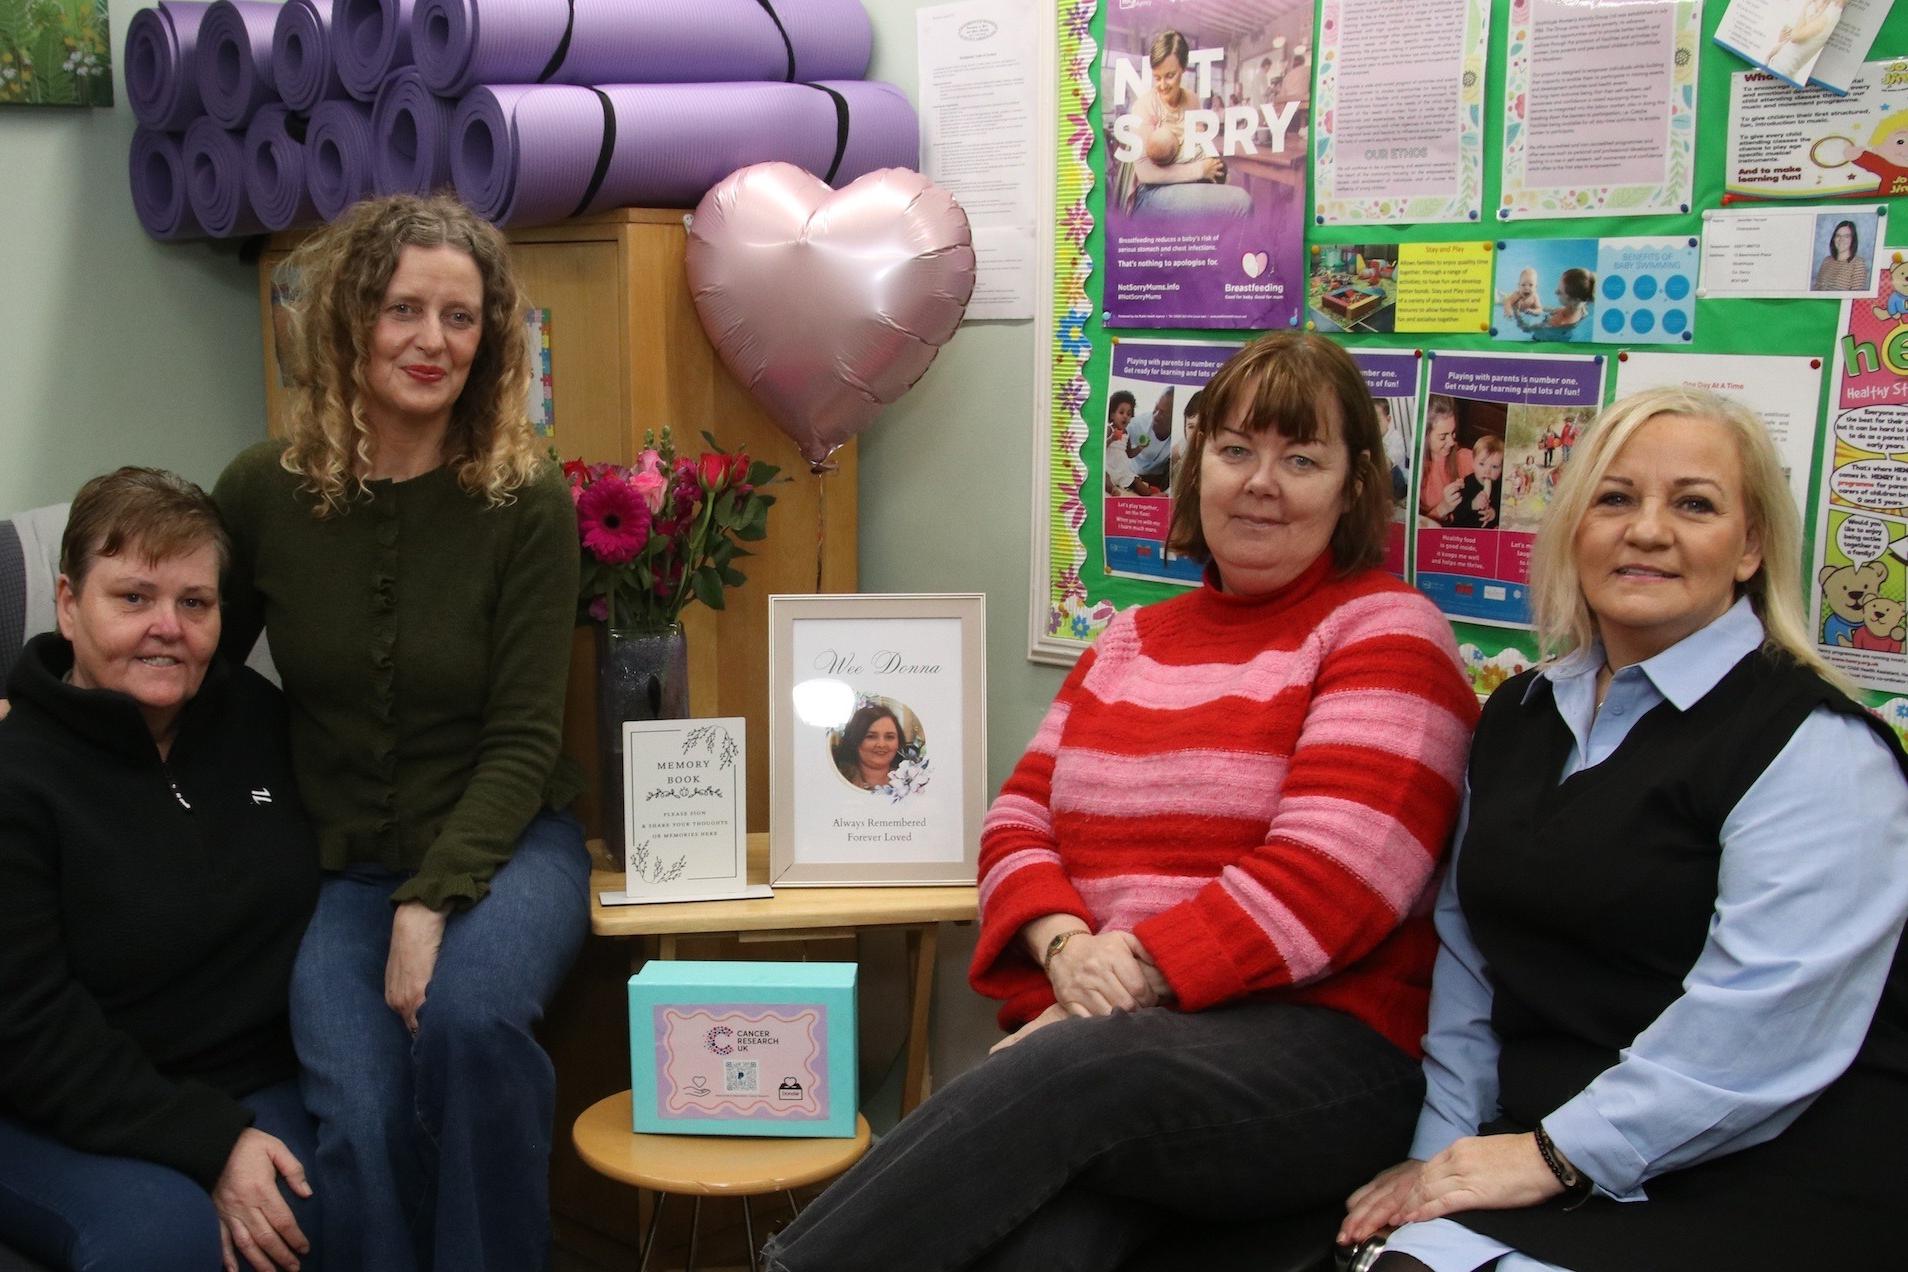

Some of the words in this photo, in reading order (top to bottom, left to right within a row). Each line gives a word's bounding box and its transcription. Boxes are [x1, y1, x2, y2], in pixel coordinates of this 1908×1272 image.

[1113, 47, 1224, 105] NT
[1113, 101, 1300, 162] SRRY
[1738, 167, 1758, 175] And
[1738, 174, 1779, 183] learning
[1426, 246, 1438, 254] Stay
[1452, 245, 1464, 254] Play
[1623, 252, 1660, 261] BENEFITS
[1661, 252, 1673, 260] OF
[1118, 259, 1137, 267] That's
[1138, 259, 1163, 268] nothing
[1173, 258, 1206, 268] apologise
[1614, 261, 1633, 269] BABY
[1636, 261, 1681, 269] SWIMMING
[1118, 283, 1180, 292] NotSorryMums.info
[1224, 283, 1284, 294] Breastfeeding
[1127, 357, 1148, 366] Playing
[1148, 358, 1160, 366] with
[1191, 360, 1215, 368] number
[1123, 366, 1135, 374] Get
[1135, 368, 1150, 376] ready
[1160, 368, 1185, 378] learning
[1381, 370, 1397, 378] one.
[1448, 371, 1474, 382] Playing
[1475, 373, 1490, 381] with
[1492, 374, 1520, 383] parents
[1529, 375, 1560, 385] number
[1561, 377, 1578, 385] one.
[1384, 380, 1399, 388] fun!
[1445, 382, 1457, 390] Get
[1457, 384, 1478, 392] ready
[1479, 383, 1488, 392] for
[1490, 384, 1521, 395] learning
[1523, 386, 1537, 394] and
[1538, 387, 1553, 395] lots
[1554, 387, 1563, 395] of
[1564, 388, 1580, 396] fun!
[1847, 384, 1890, 400] Healthy
[1864, 409, 1894, 417] Everyone
[1887, 417, 1903, 425] their
[1869, 424, 1878, 432] be
[1879, 425, 1896, 433] hard
[1882, 434, 1905, 442] parent
[1866, 442, 1883, 450] early
[1851, 464, 1871, 472] That's
[1838, 480, 1874, 488] programme
[1848, 518, 1868, 526] Would
[1464, 536, 1476, 544] food
[1843, 534, 1861, 542] being
[1843, 541, 1872, 549] together
[1853, 549, 1876, 558] family?
[813, 647, 865, 675] Wee
[870, 649, 941, 675] Donna
[657, 760, 710, 770] MEMORY
[667, 775, 700, 784] BOOK
[832, 818, 865, 830] Always
[868, 817, 927, 828] Remembered
[847, 832, 881, 842] Forever
[884, 832, 912, 841] Loved
